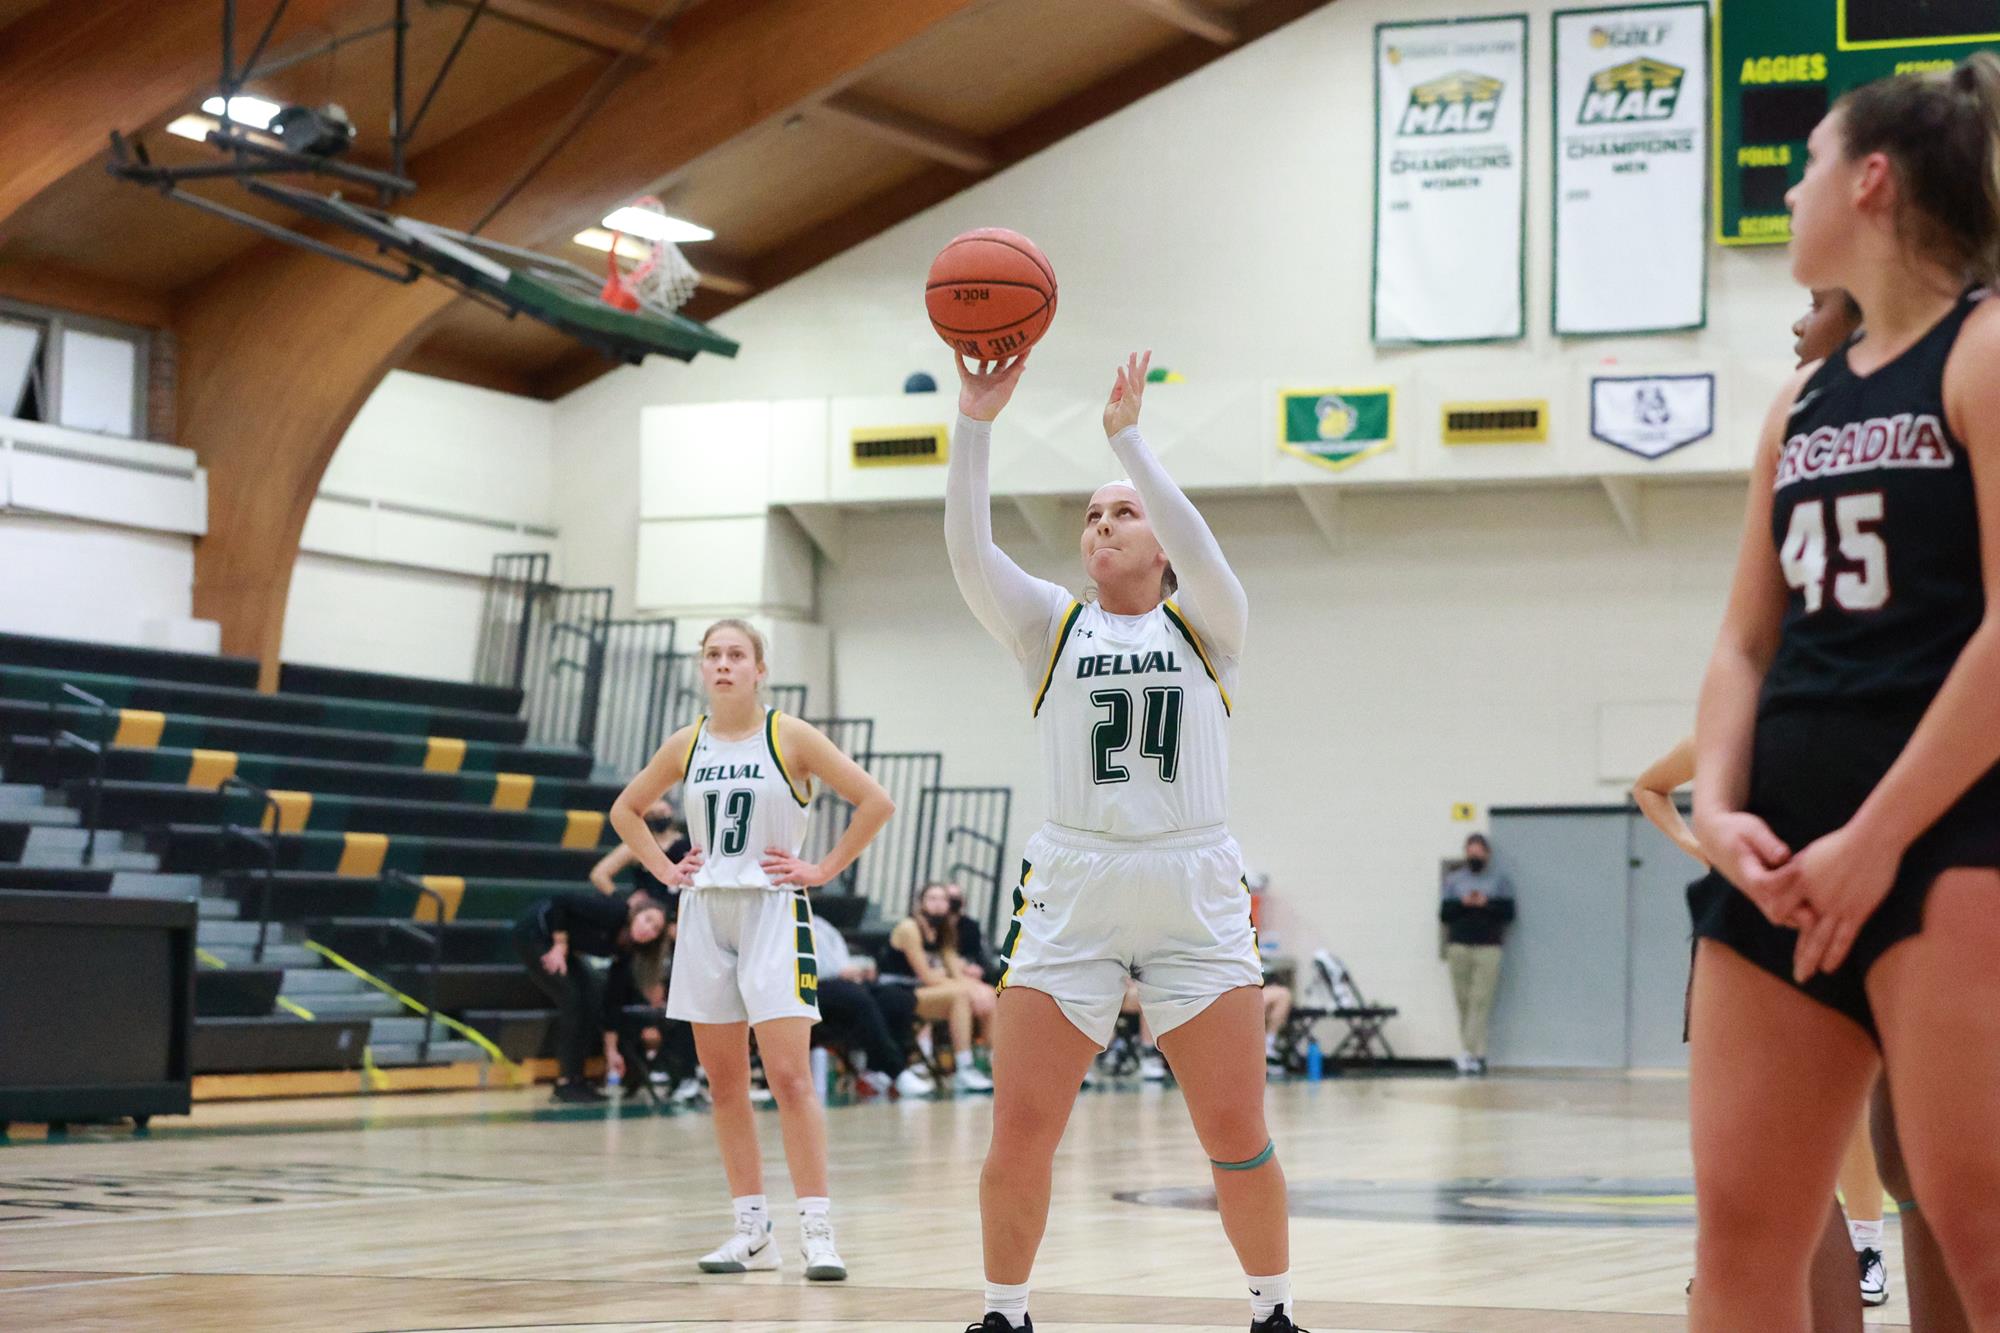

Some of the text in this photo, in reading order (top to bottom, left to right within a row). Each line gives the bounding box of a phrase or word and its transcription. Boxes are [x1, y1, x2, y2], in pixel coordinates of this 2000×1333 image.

[1741, 53, 1828, 84] AGGIES
[1398, 99, 1499, 135] MAC
[1579, 86, 1678, 123] MAC
[1566, 137, 1693, 159] CHAMPIONS
[1738, 145, 1792, 168] FOULS
[1391, 152, 1512, 175] CHAMPIONS
[953, 288, 989, 301] ROCK
[988, 330, 1028, 356] THE
[1773, 413, 1954, 490] RCADIA
[1779, 492, 1890, 614] 45
[1076, 650, 1182, 679] DELVAL
[1090, 686, 1184, 785] 24
[693, 762, 765, 784] DELVAL
[703, 788, 756, 858] 13
